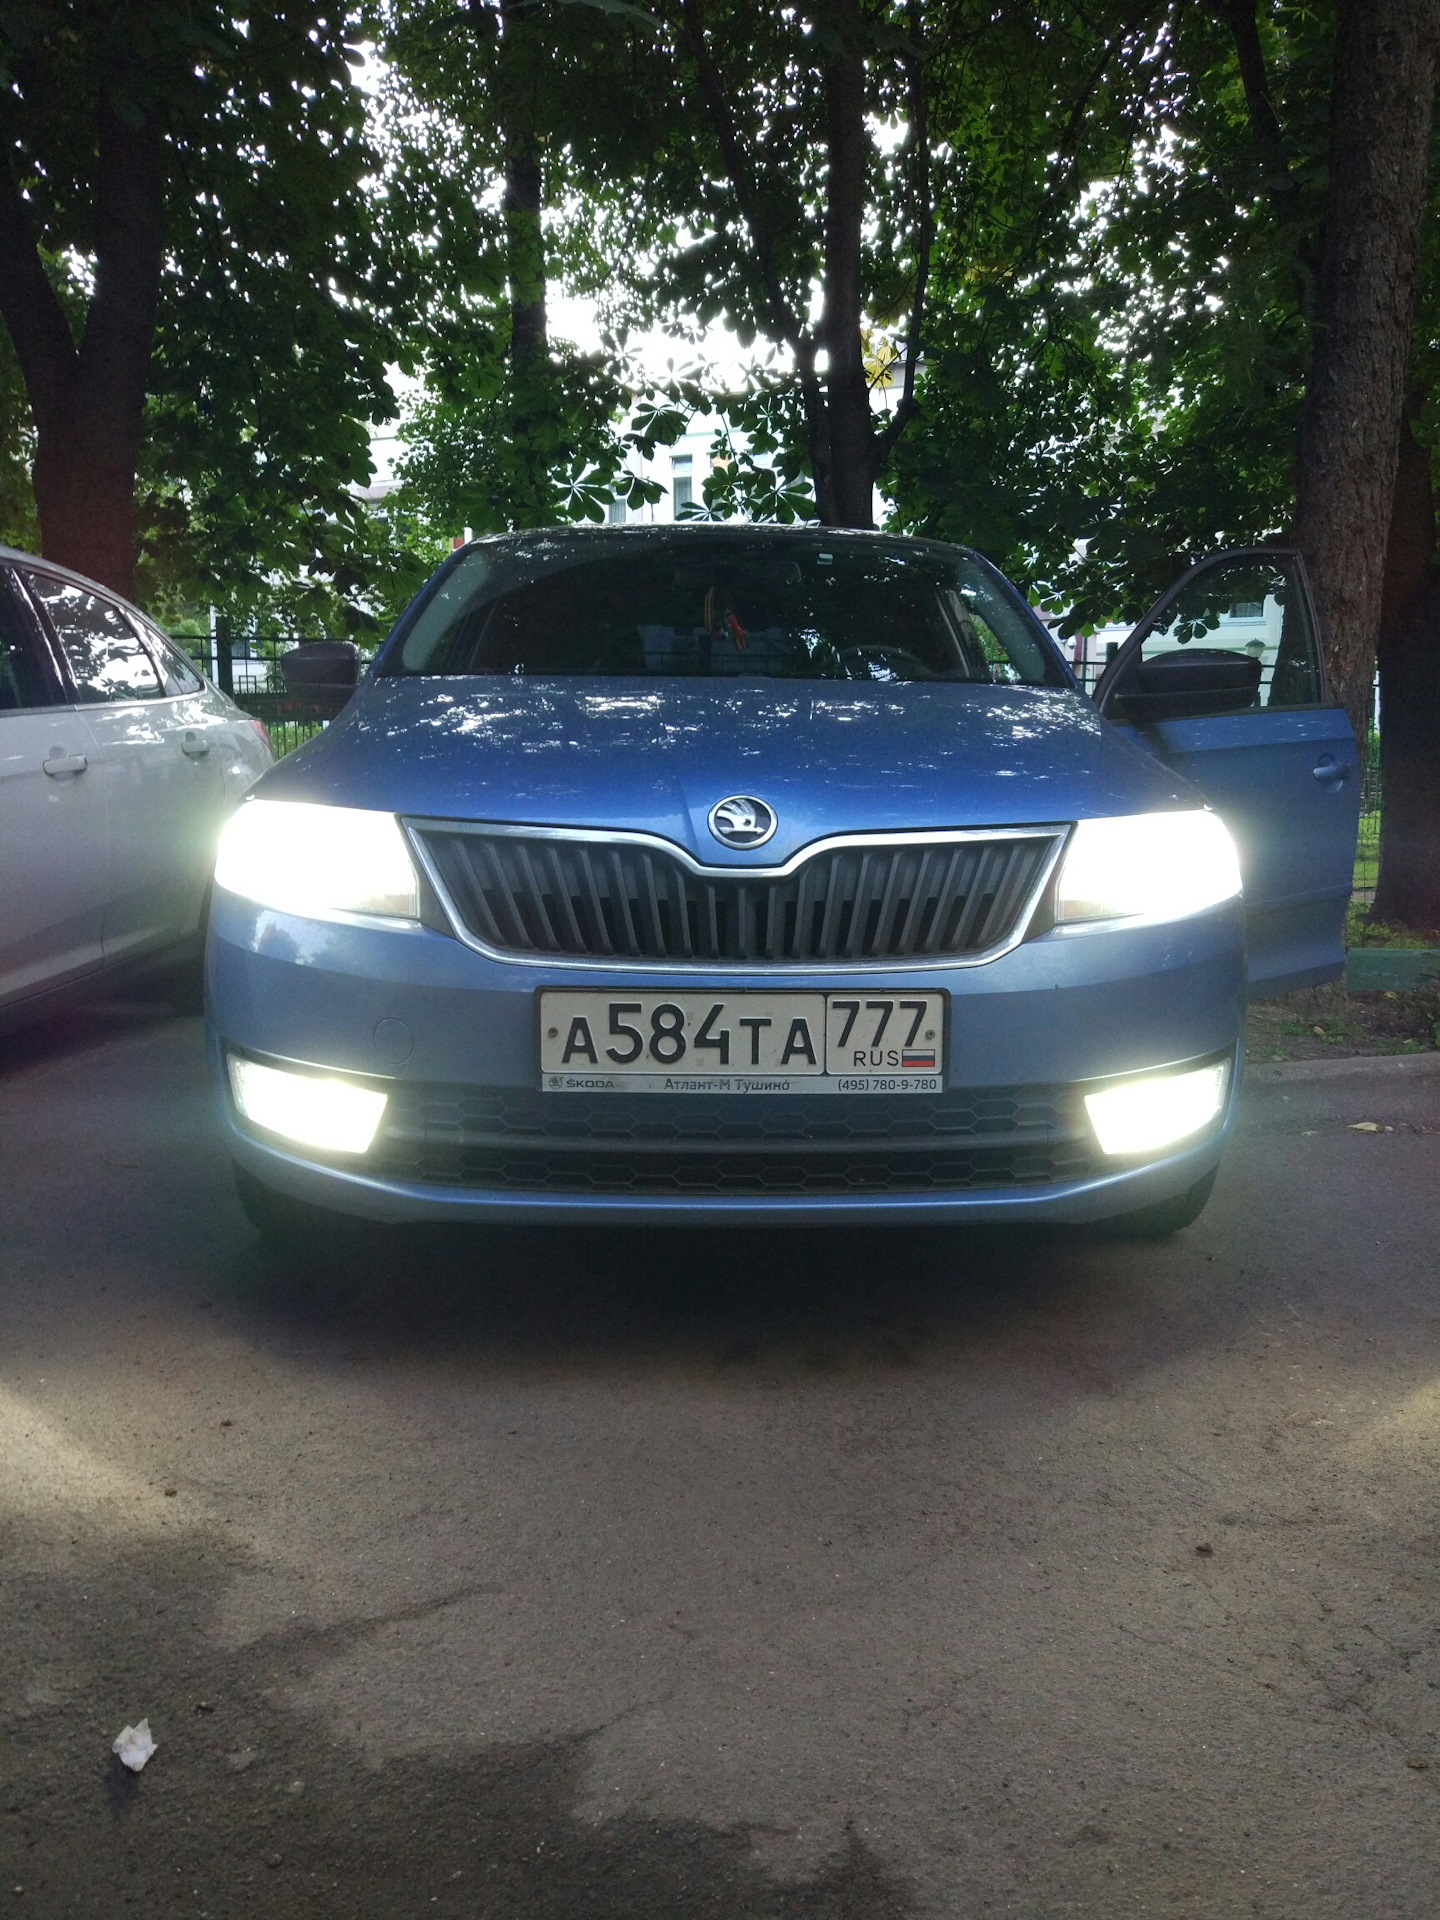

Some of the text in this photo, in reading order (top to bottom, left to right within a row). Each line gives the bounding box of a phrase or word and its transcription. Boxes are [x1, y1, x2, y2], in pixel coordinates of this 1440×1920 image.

[832, 1000, 928, 1047] 777
[853, 1050, 899, 1067] RUS
[735, 1078, 790, 1093] Тушино
[837, 1079, 937, 1091] (495) 780-9-780
